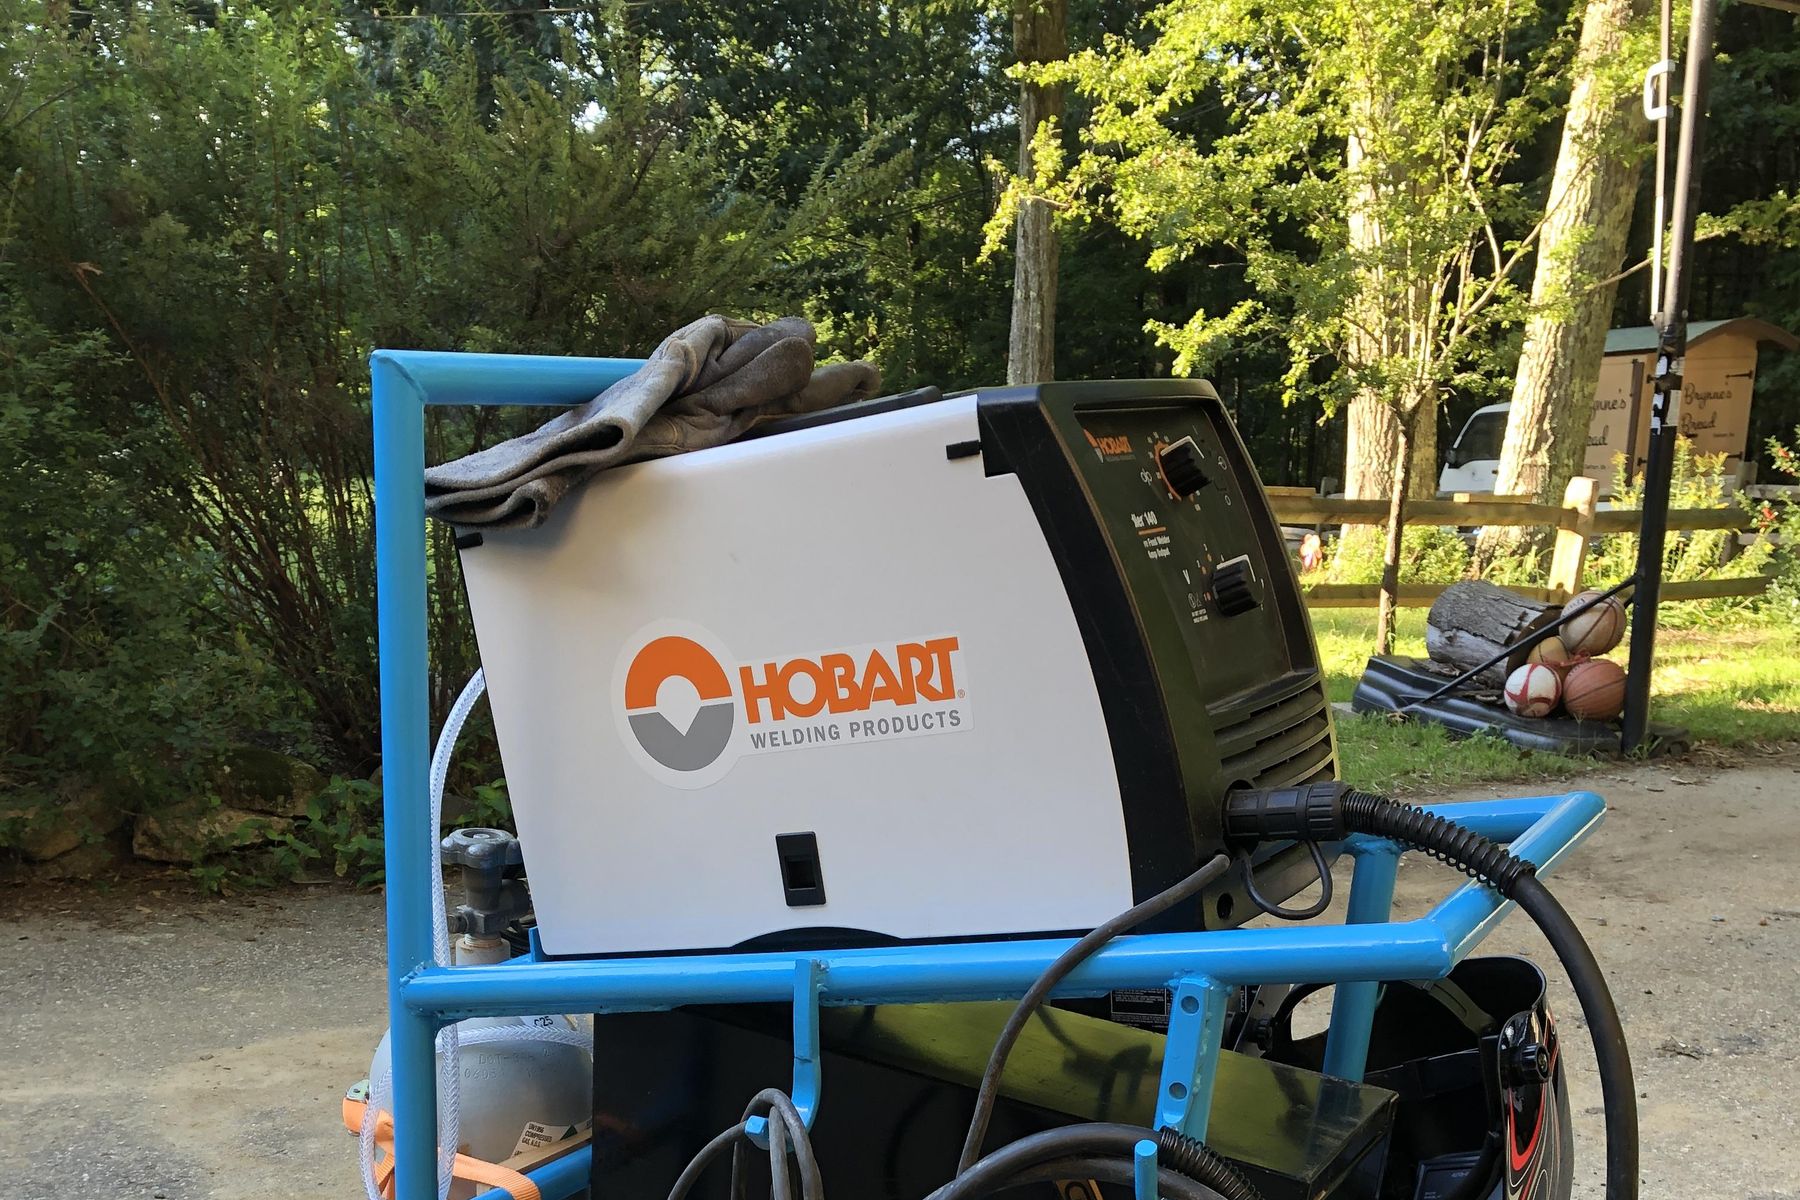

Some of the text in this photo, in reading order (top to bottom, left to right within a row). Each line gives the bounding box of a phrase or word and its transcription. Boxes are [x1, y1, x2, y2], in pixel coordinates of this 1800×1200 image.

[739, 636, 960, 724] HOBART
[750, 709, 962, 749] WELDING PRODUCTS
